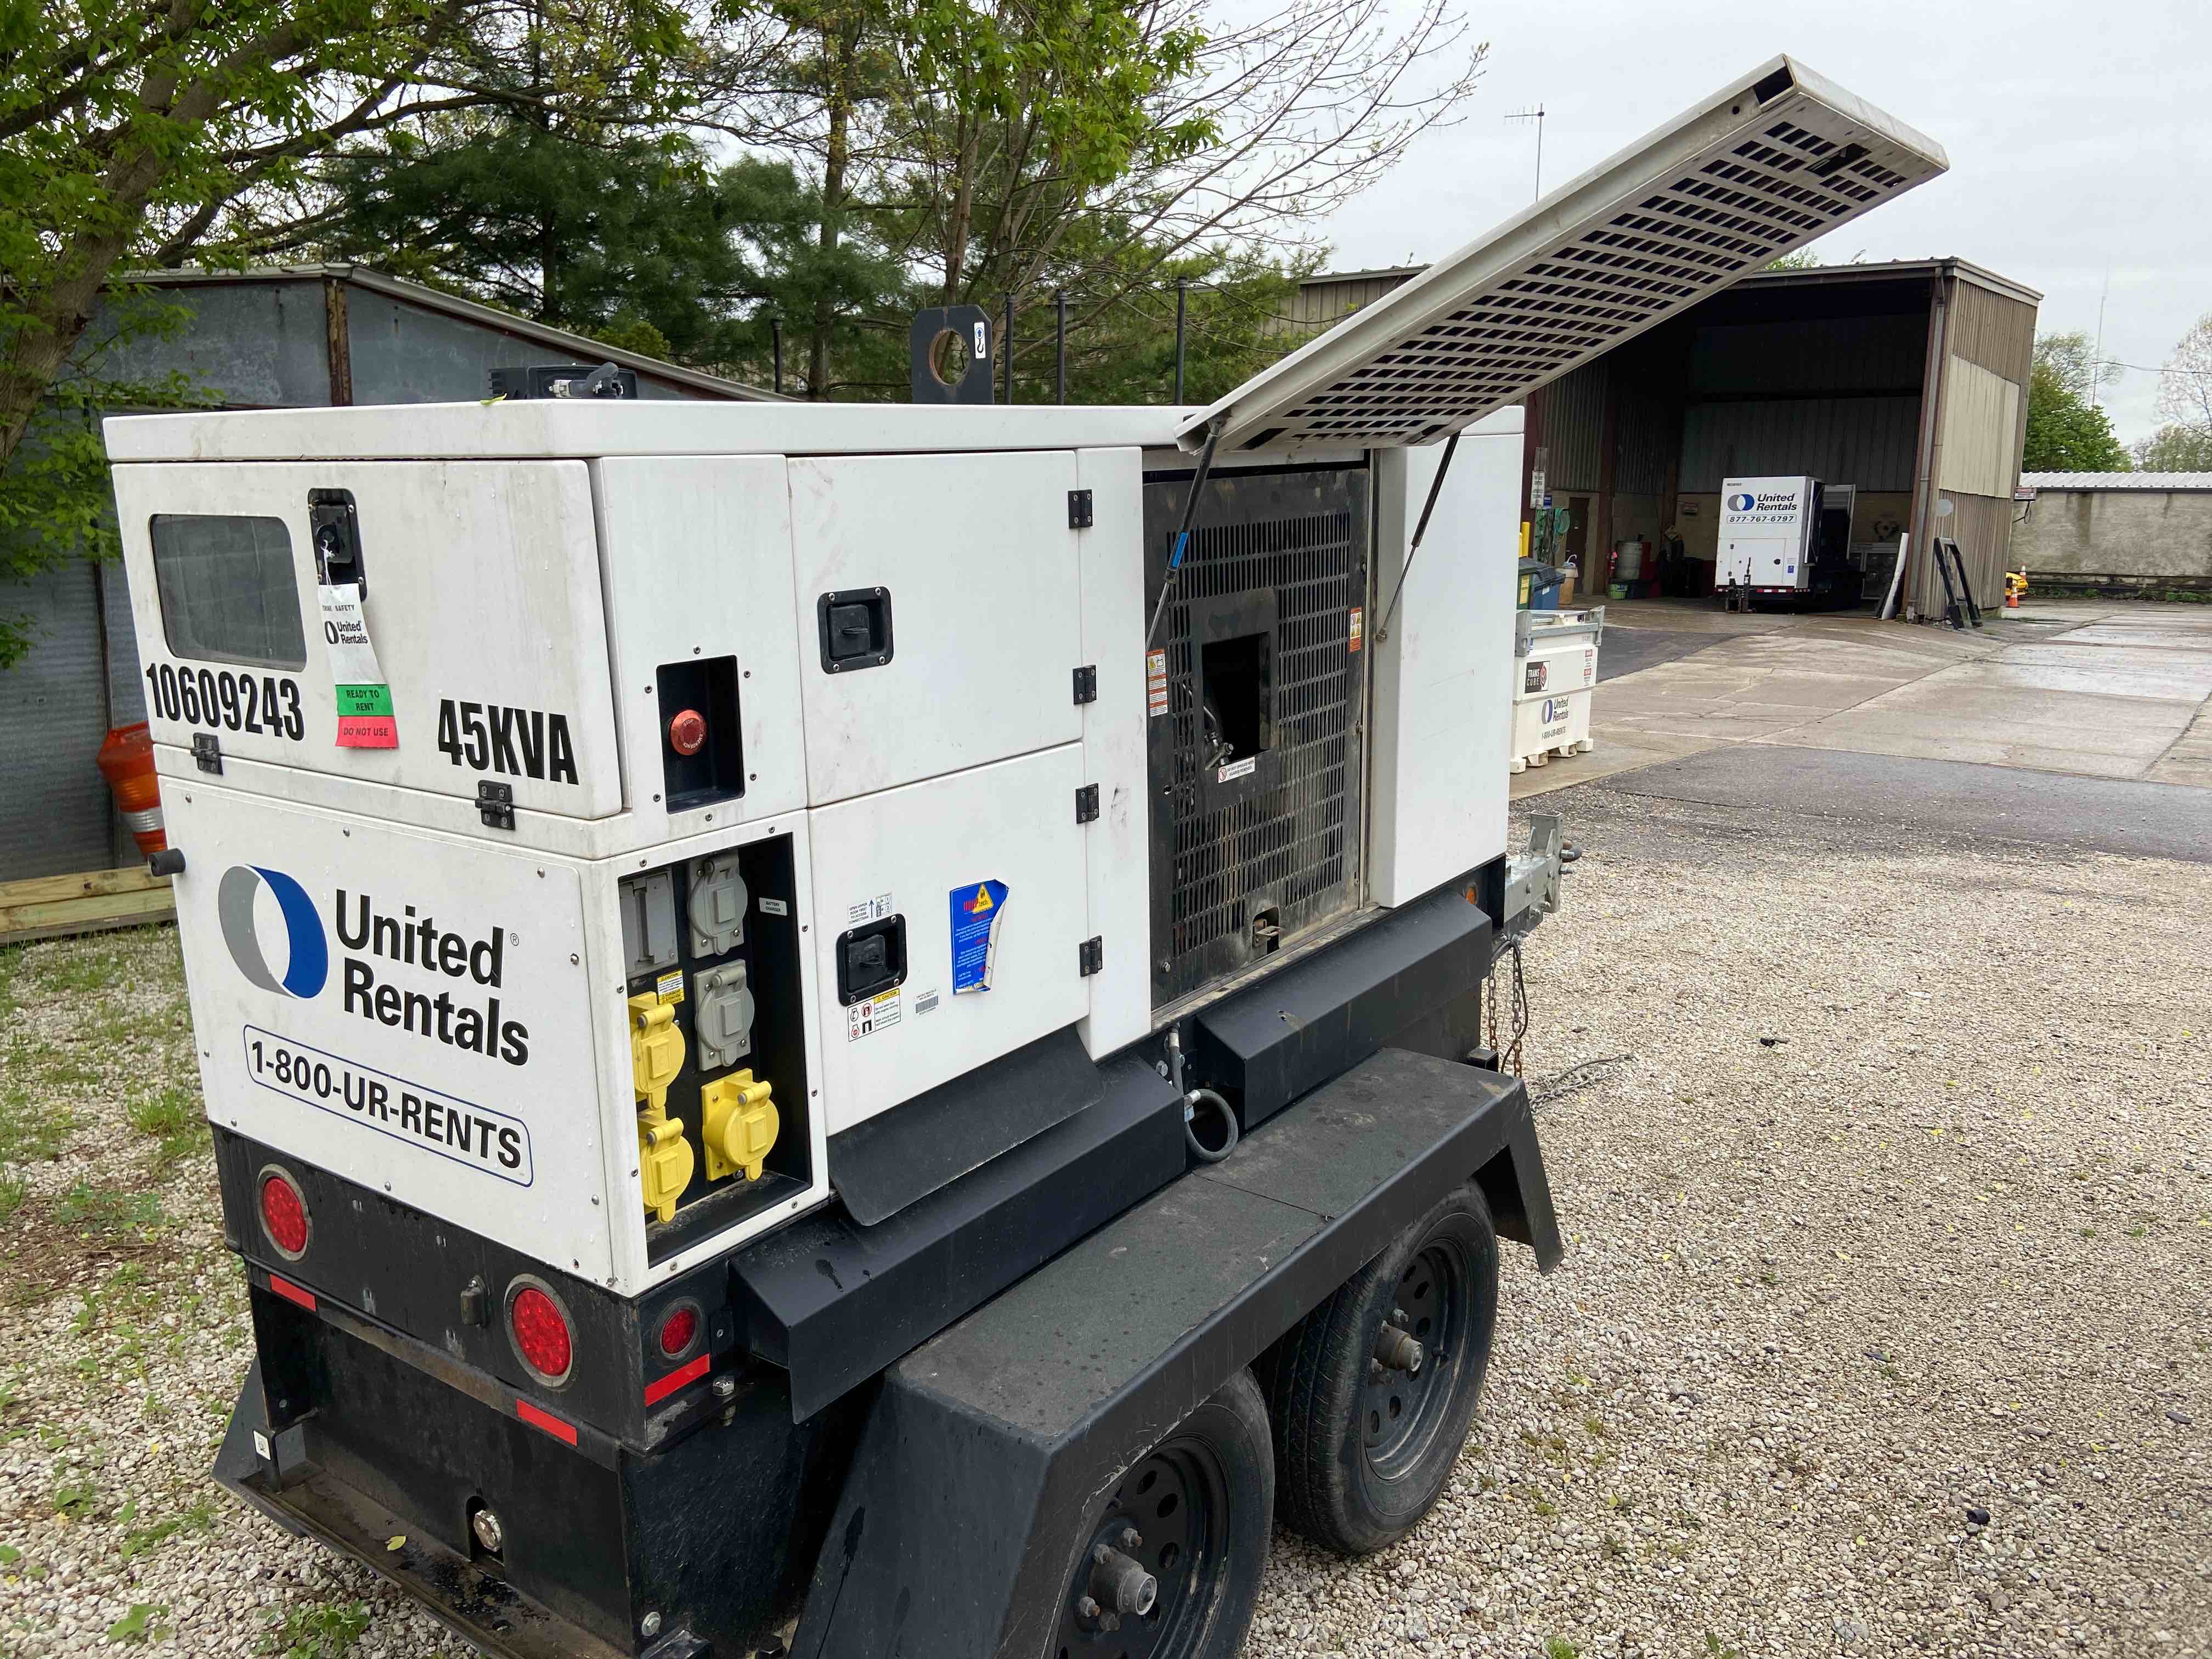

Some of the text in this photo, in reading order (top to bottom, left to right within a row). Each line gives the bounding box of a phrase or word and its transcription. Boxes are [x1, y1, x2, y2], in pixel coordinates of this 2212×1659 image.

[1757, 493, 1795, 502] United
[1757, 502, 1797, 511] Rentals
[336, 620, 362, 632] United
[340, 633, 368, 644] Rentals
[1527, 668, 1540, 677] TRANS
[1527, 677, 1540, 686] CUBE
[346, 689, 380, 698] READY TO
[146, 663, 304, 741] 10609243
[356, 702, 374, 712] RENT
[1554, 696, 1570, 709] United
[1553, 708, 1569, 722] Rentals
[343, 727, 388, 737] DO NOT USE
[438, 698, 580, 785] 45KVA
[336, 889, 504, 989] United
[882, 990, 897, 999] CAUTION
[344, 957, 528, 1066] Rentals
[252, 1040, 521, 1169] 1-800-UR-RENTS
